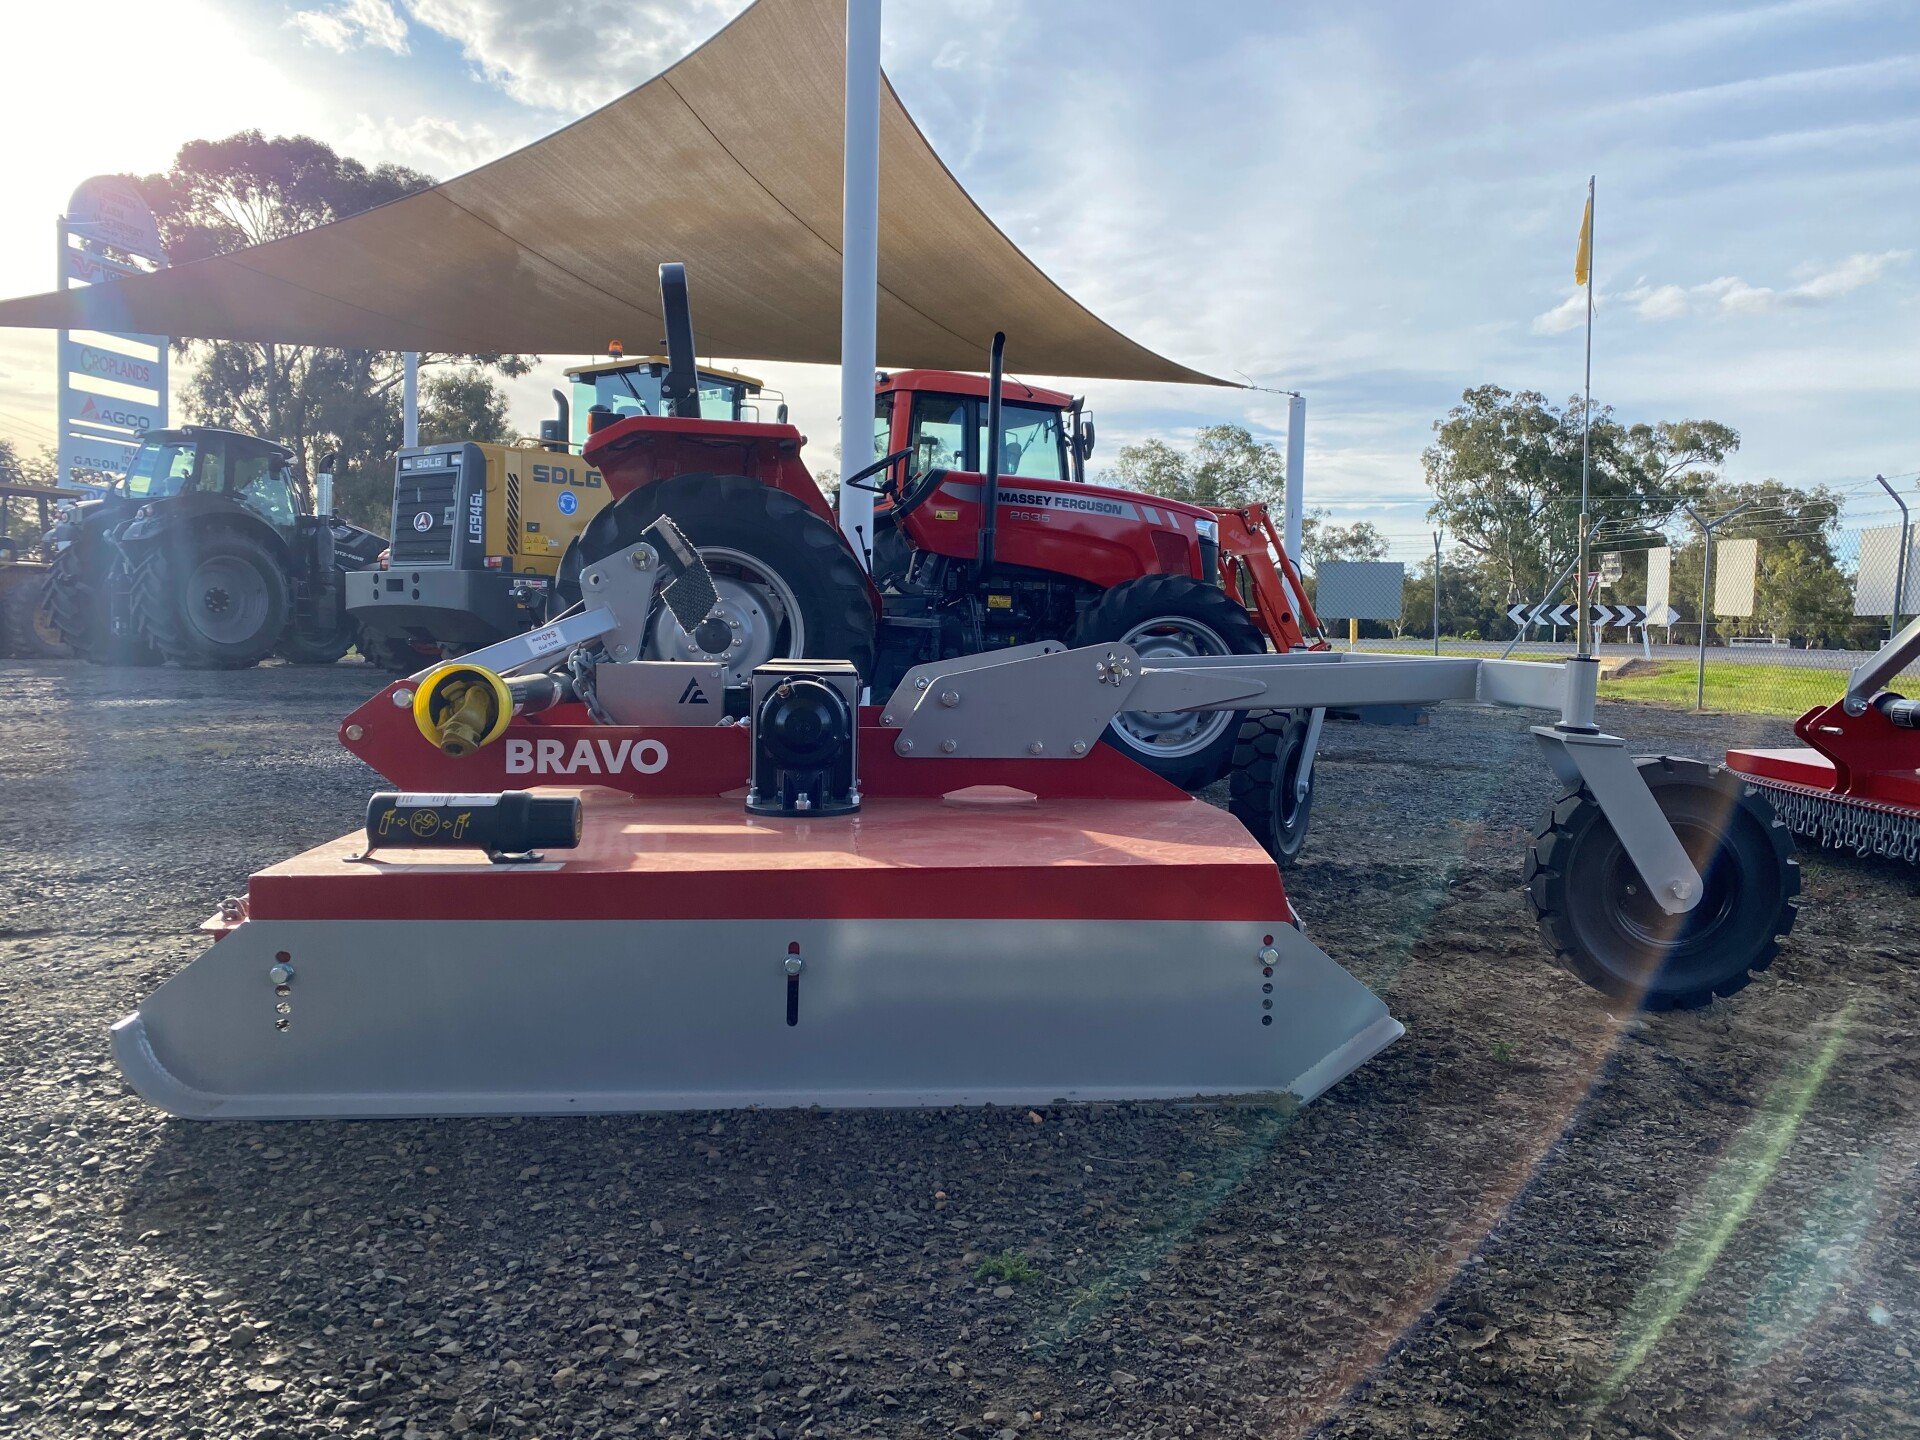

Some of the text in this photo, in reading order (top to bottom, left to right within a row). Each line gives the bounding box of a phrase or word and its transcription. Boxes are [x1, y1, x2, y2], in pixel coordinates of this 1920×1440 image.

[80, 348, 150, 382] CROPLANDS
[101, 409, 150, 429] AGCO
[73, 455, 119, 470] GASON
[416, 457, 443, 469] SDLG
[532, 464, 602, 489] SDLG
[997, 492, 1123, 515] MASSEY FERGUSON
[468, 488, 484, 544] LG946L
[1009, 510, 1052, 523] 2635
[541, 630, 556, 640] 540
[505, 738, 669, 775] BRAVO
